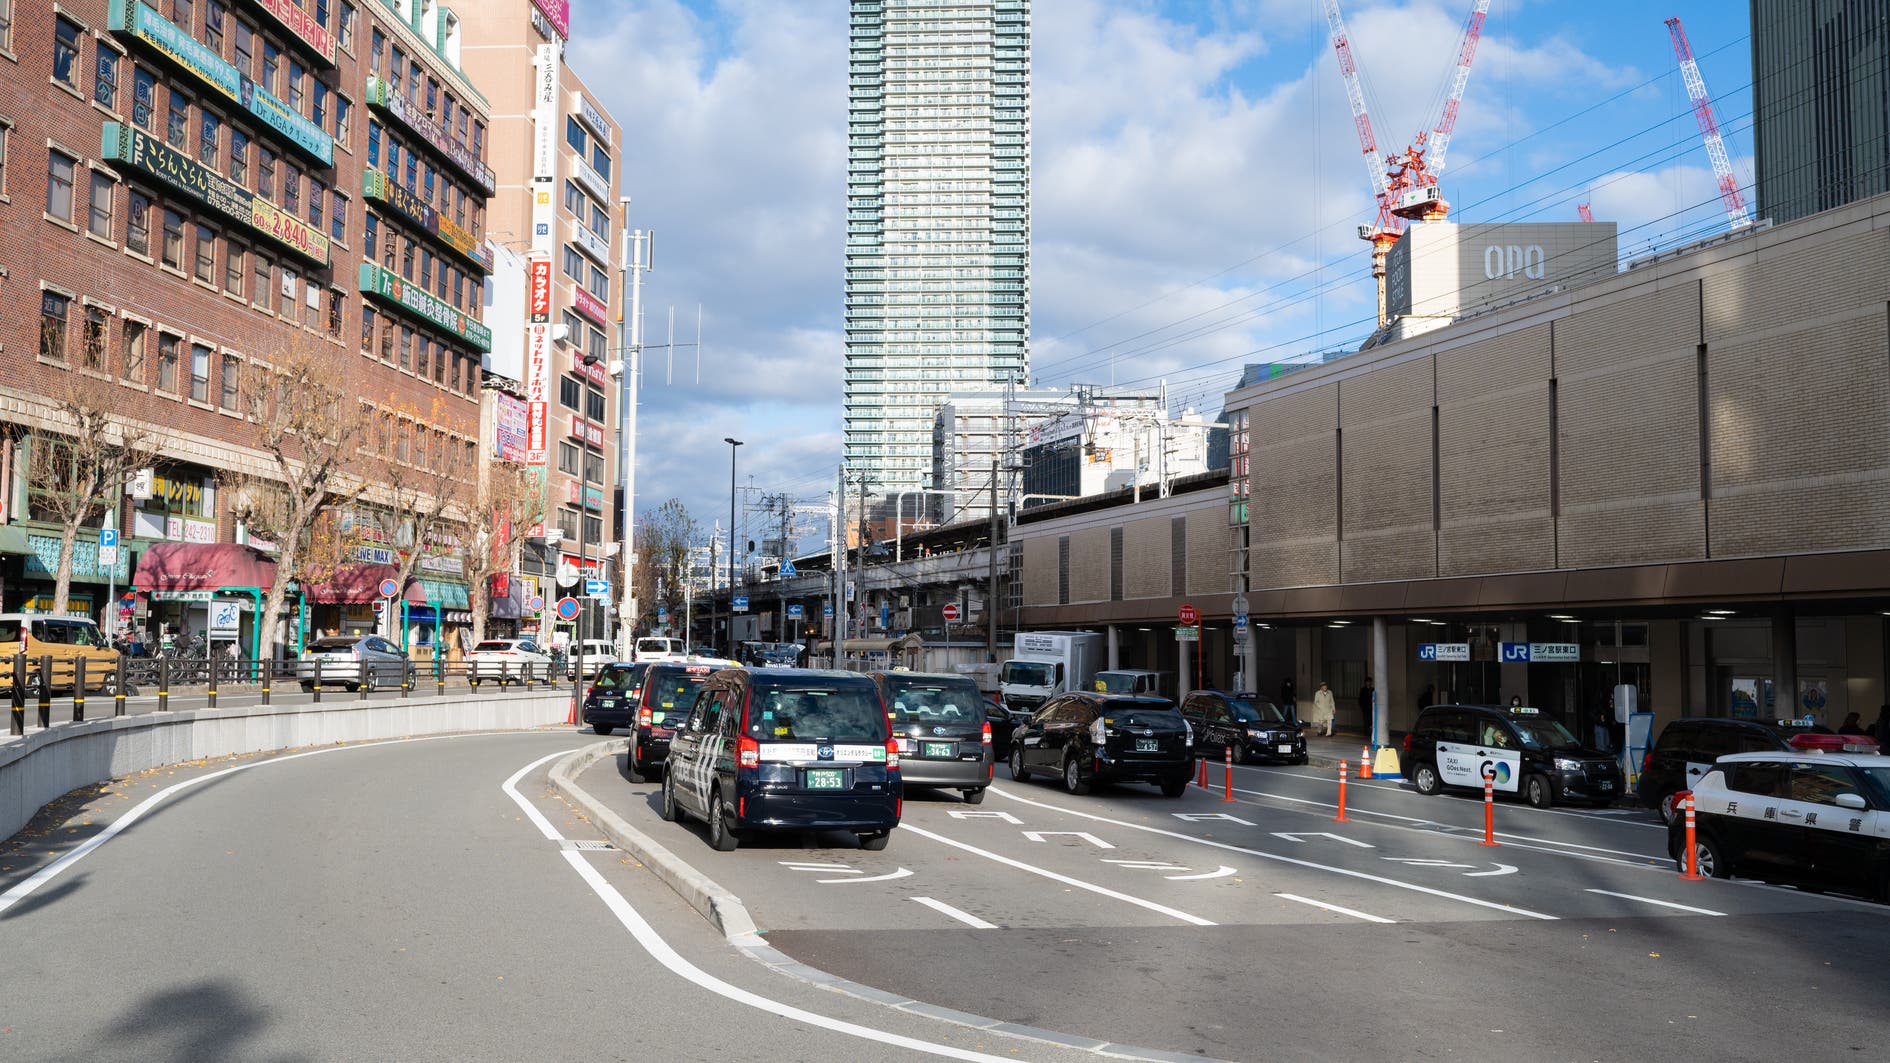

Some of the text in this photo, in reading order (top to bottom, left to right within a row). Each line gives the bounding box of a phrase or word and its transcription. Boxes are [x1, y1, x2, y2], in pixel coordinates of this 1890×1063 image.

[134, 133, 144, 165] 5F
[534, 263, 547, 311] カラオケ
[534, 314, 545, 322] 5F
[529, 451, 542, 461] 3F
[168, 520, 180, 537] TEL
[104, 531, 113, 543] P
[374, 549, 389, 563] MAX
[1420, 646, 1434, 659] JR
[1436, 646, 1467, 654] 三ノ宮駅東口
[1506, 647, 1527, 660] JR
[1533, 646, 1577, 654] 三ノ宮駅東口
[931, 748, 950, 756] 34-63
[814, 778, 841, 788] 28-53
